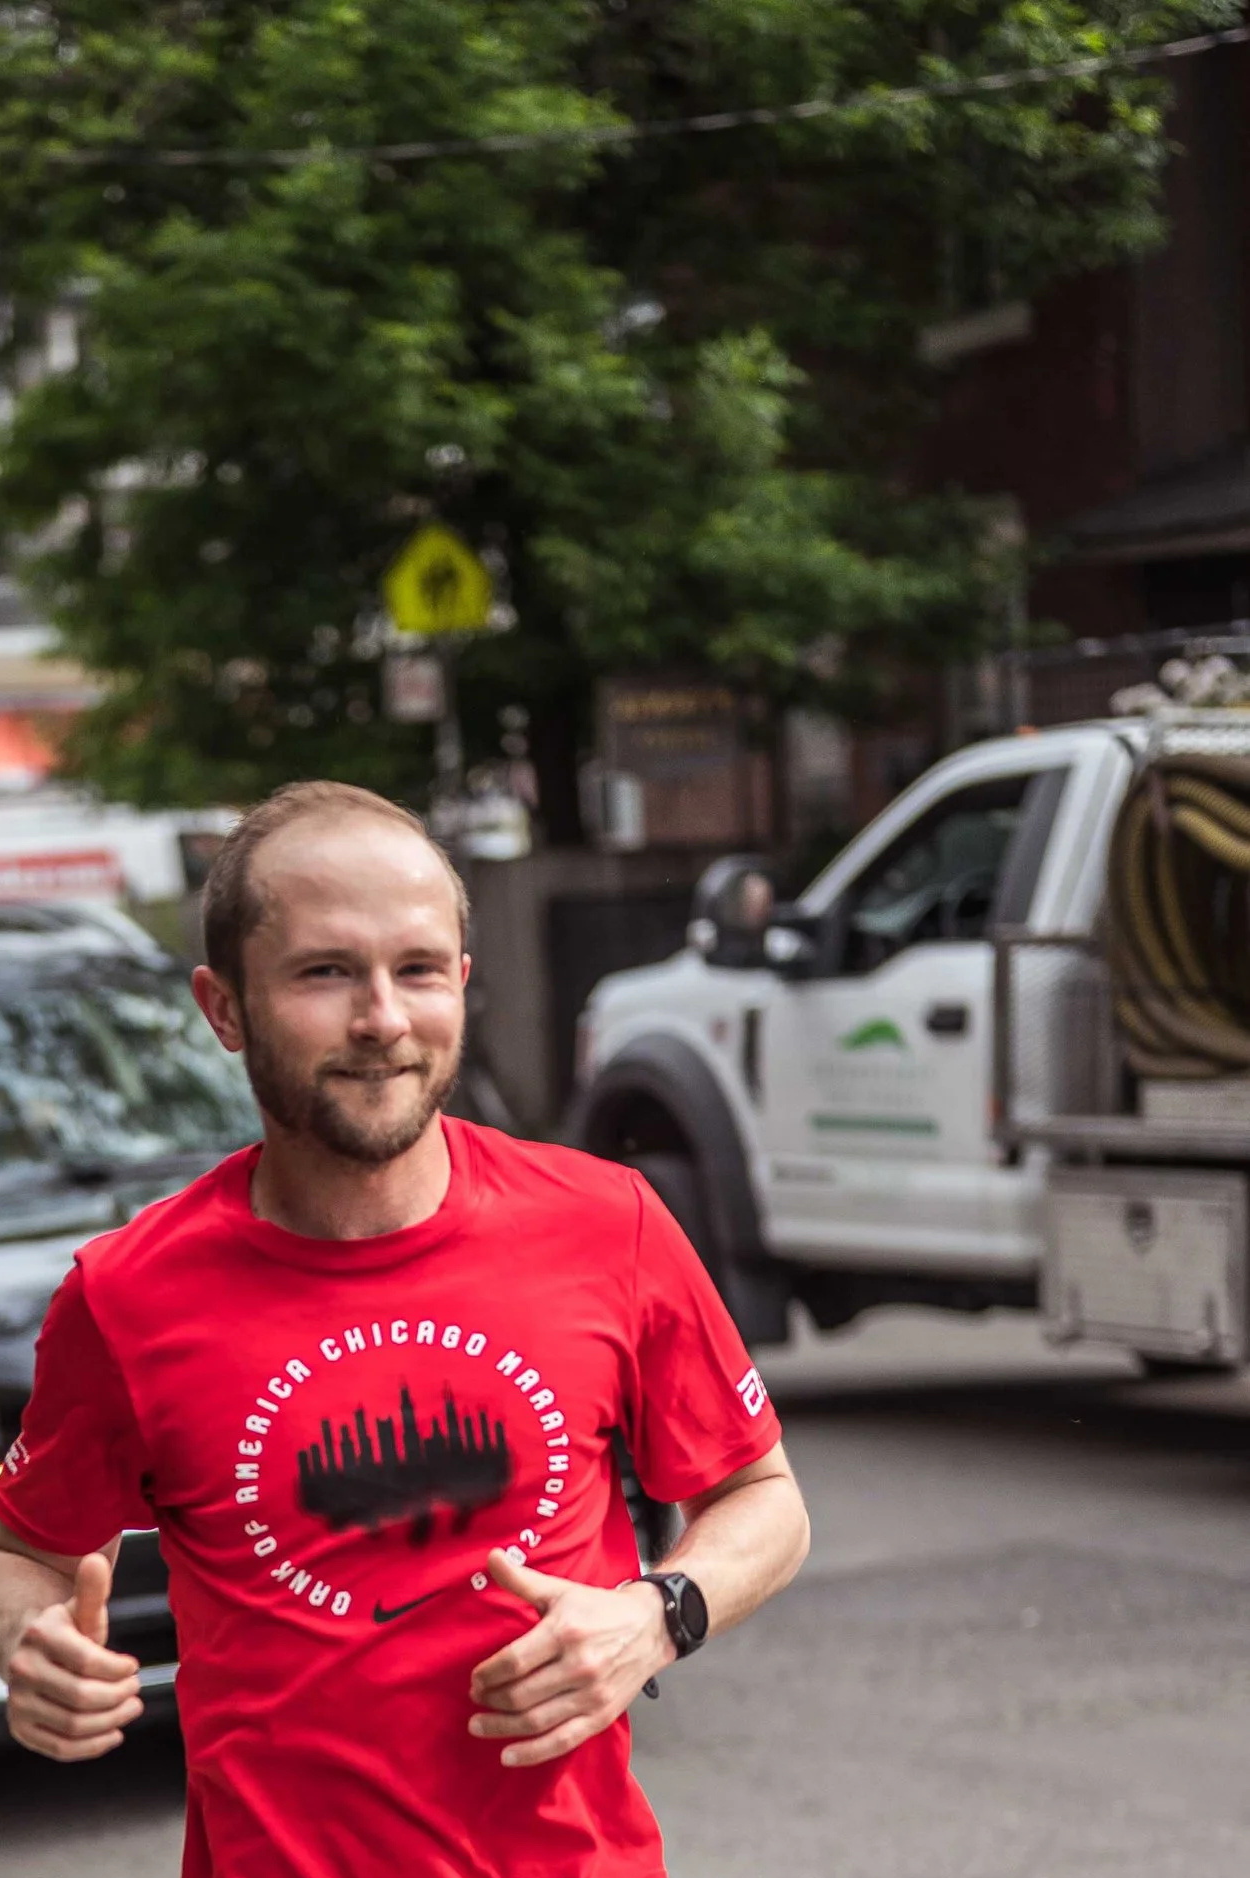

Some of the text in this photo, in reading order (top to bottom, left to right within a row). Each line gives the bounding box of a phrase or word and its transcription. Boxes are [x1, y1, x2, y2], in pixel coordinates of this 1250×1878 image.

[235, 1319, 570, 1616] BANK OF AMERICA CHICAGO MARATHON 209
